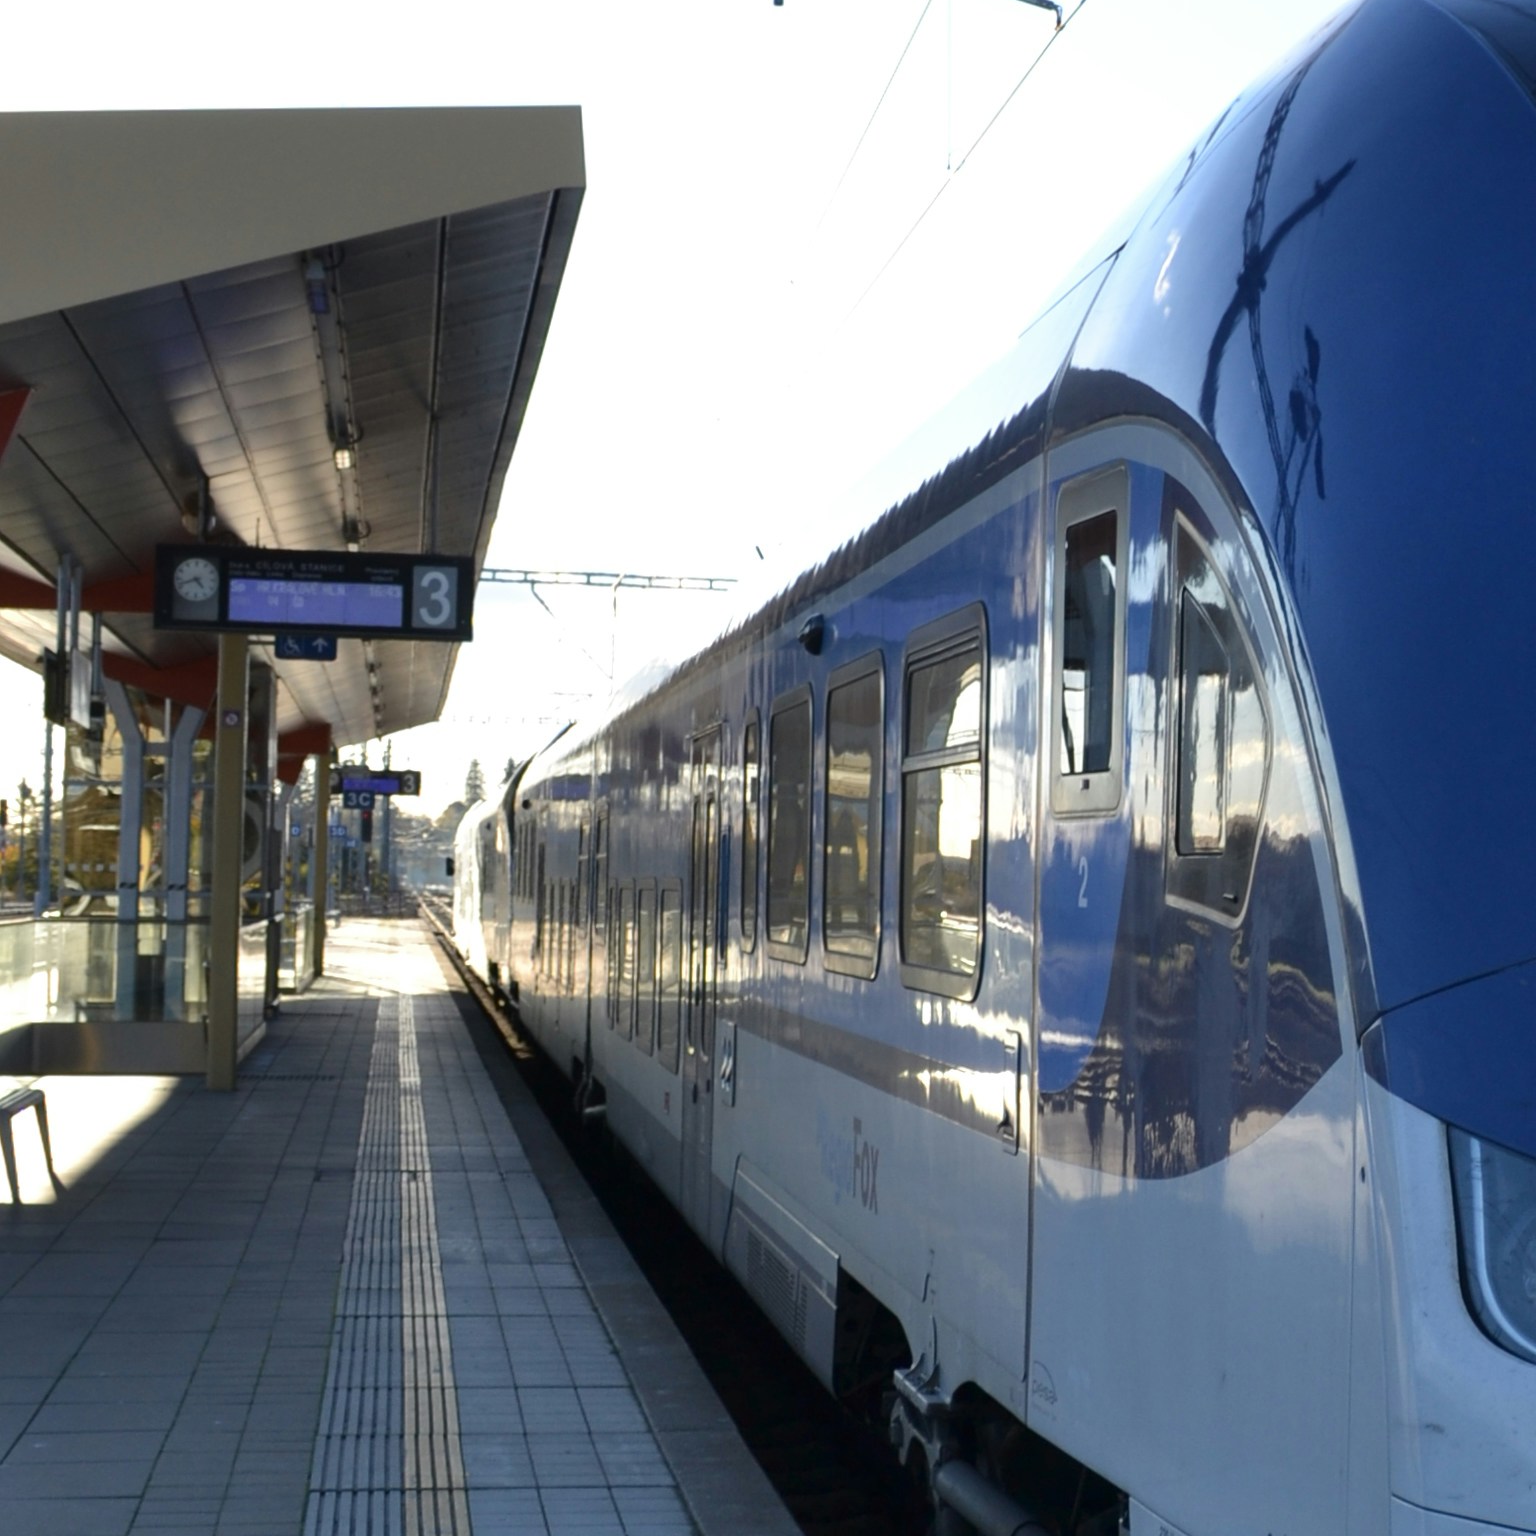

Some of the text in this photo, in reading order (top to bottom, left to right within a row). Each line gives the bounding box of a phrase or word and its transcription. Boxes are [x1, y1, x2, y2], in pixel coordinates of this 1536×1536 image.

[419, 571, 451, 626] 3
[347, 792, 371, 806] 3C
[403, 774, 416, 793] 3
[1078, 855, 1089, 909] 2
